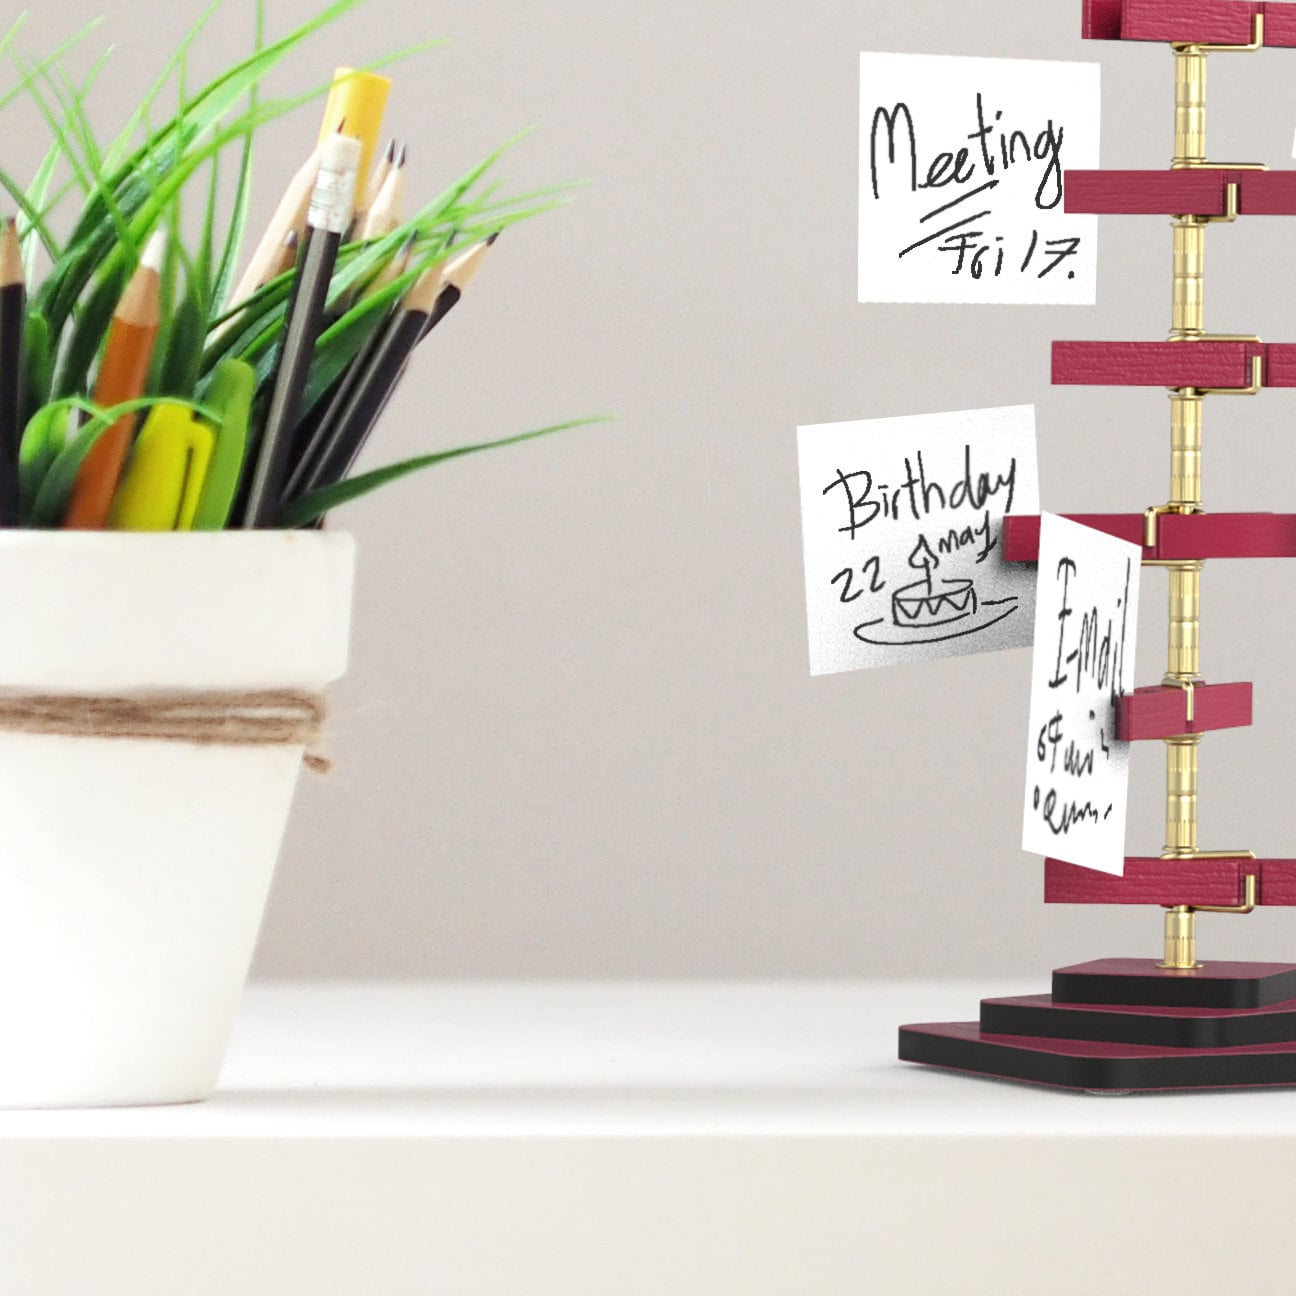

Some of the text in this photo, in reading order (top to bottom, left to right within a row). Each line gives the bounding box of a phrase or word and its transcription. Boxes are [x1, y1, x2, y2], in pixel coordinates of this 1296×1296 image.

[870, 92, 1064, 210] Meeting
[938, 231, 1004, 280] Fri
[822, 444, 1016, 540] Birthday
[830, 555, 887, 603] 22
